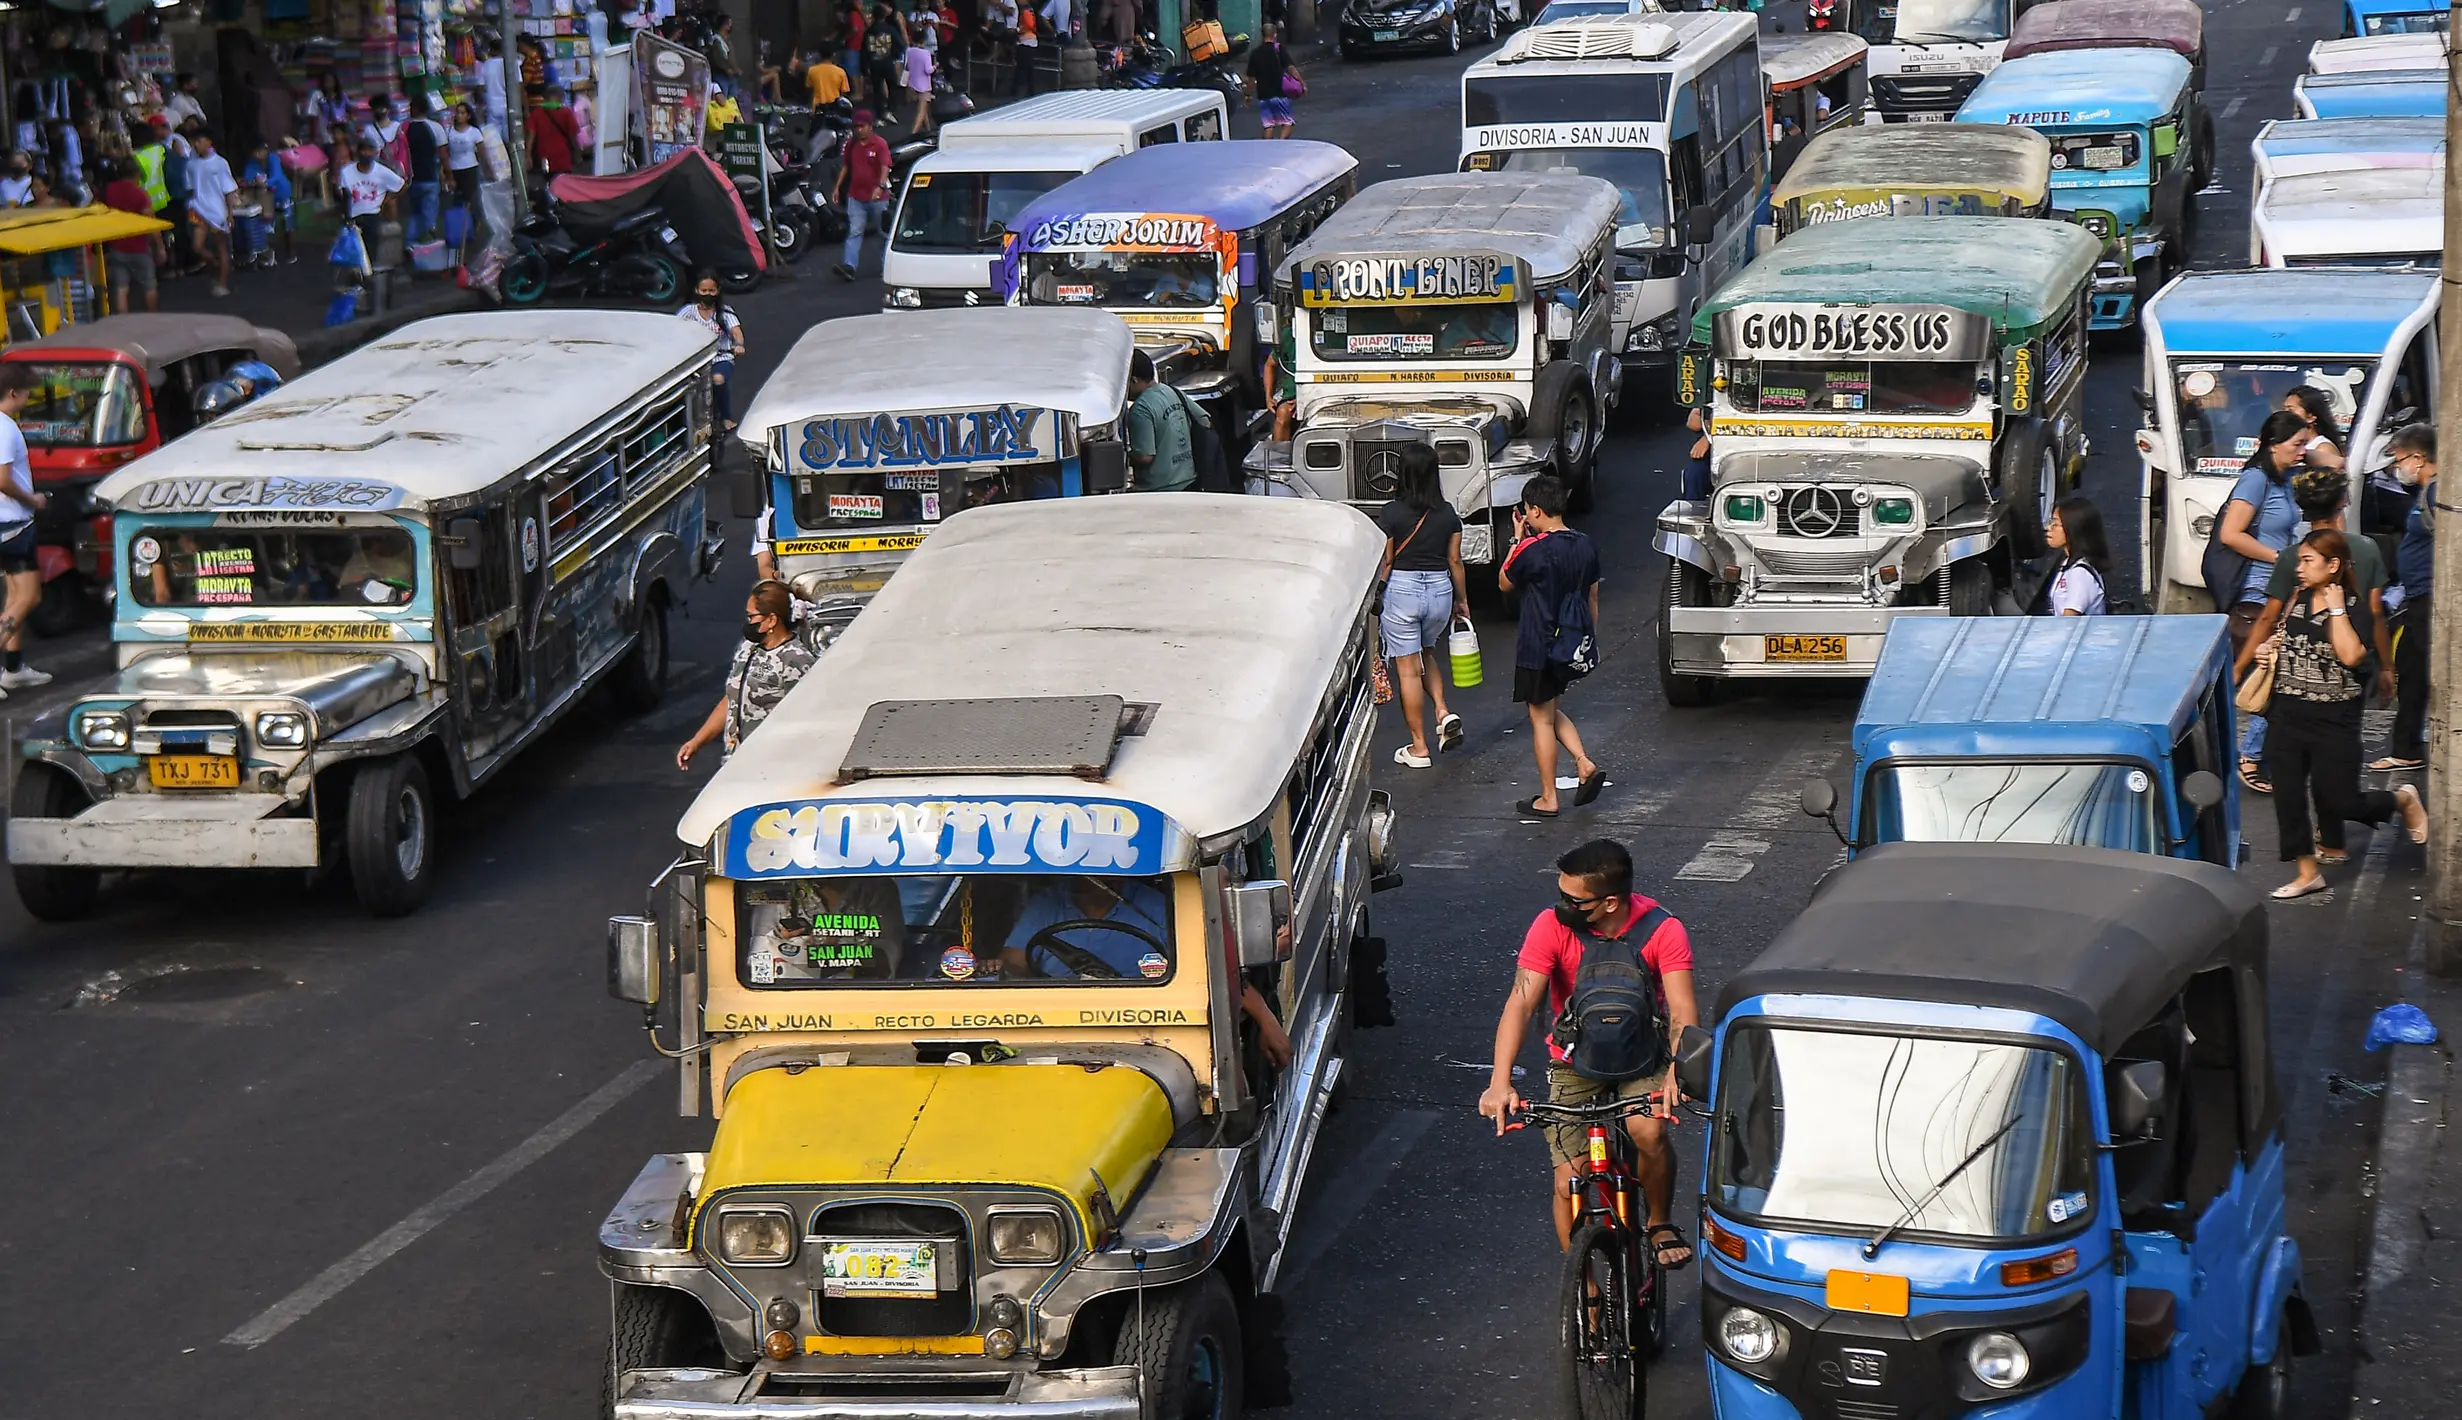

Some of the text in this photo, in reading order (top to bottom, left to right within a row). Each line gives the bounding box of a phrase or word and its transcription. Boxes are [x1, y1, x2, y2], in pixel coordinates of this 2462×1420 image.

[2007, 108, 2111, 125] MAPUTE Family
[1480, 128, 1557, 147] DIVISORIA
[1571, 127, 1603, 144] SAN
[1607, 126, 1650, 144] JUAN
[1029, 219, 1205, 246] ASHER JORIM
[1313, 255, 1502, 301] FRONT LINER
[1059, 287, 1093, 295] MORAYTA
[1743, 313, 1951, 352] GOD BLESS US
[1349, 336, 1389, 346] QUIAPO
[1322, 373, 1359, 382] QUIAPO
[1400, 373, 1436, 381] HARBOR
[1464, 372, 1512, 381] DIVISORIA
[1681, 355, 1696, 404] ARAO
[2012, 348, 2030, 410] SARAO
[1762, 387, 1806, 396] AVENIDA
[800, 405, 1045, 470] STANLEY
[2200, 459, 2244, 468] QUIRINO
[138, 480, 266, 508] UNICA
[831, 497, 880, 507] MORAYTA
[785, 537, 926, 552] DIVISORIA MORAY
[218, 549, 252, 560] RECTO
[198, 577, 252, 594] MORAYTA
[189, 624, 245, 639] DIVISORIA
[313, 624, 389, 639] GASTAMBIDE
[1768, 638, 1842, 653] DLA 256
[159, 763, 230, 779] TXJ 731
[746, 801, 1140, 872] SURVIVOR
[815, 915, 880, 929] AVENIDA
[809, 945, 873, 959] SAN JUAN
[830, 959, 862, 967] MAPA
[724, 1010, 1187, 1030] SAN JUAN RECTO LEGARDA DIVISORIA
[846, 1255, 900, 1278] 082
[828, 1288, 845, 1296] 2022
